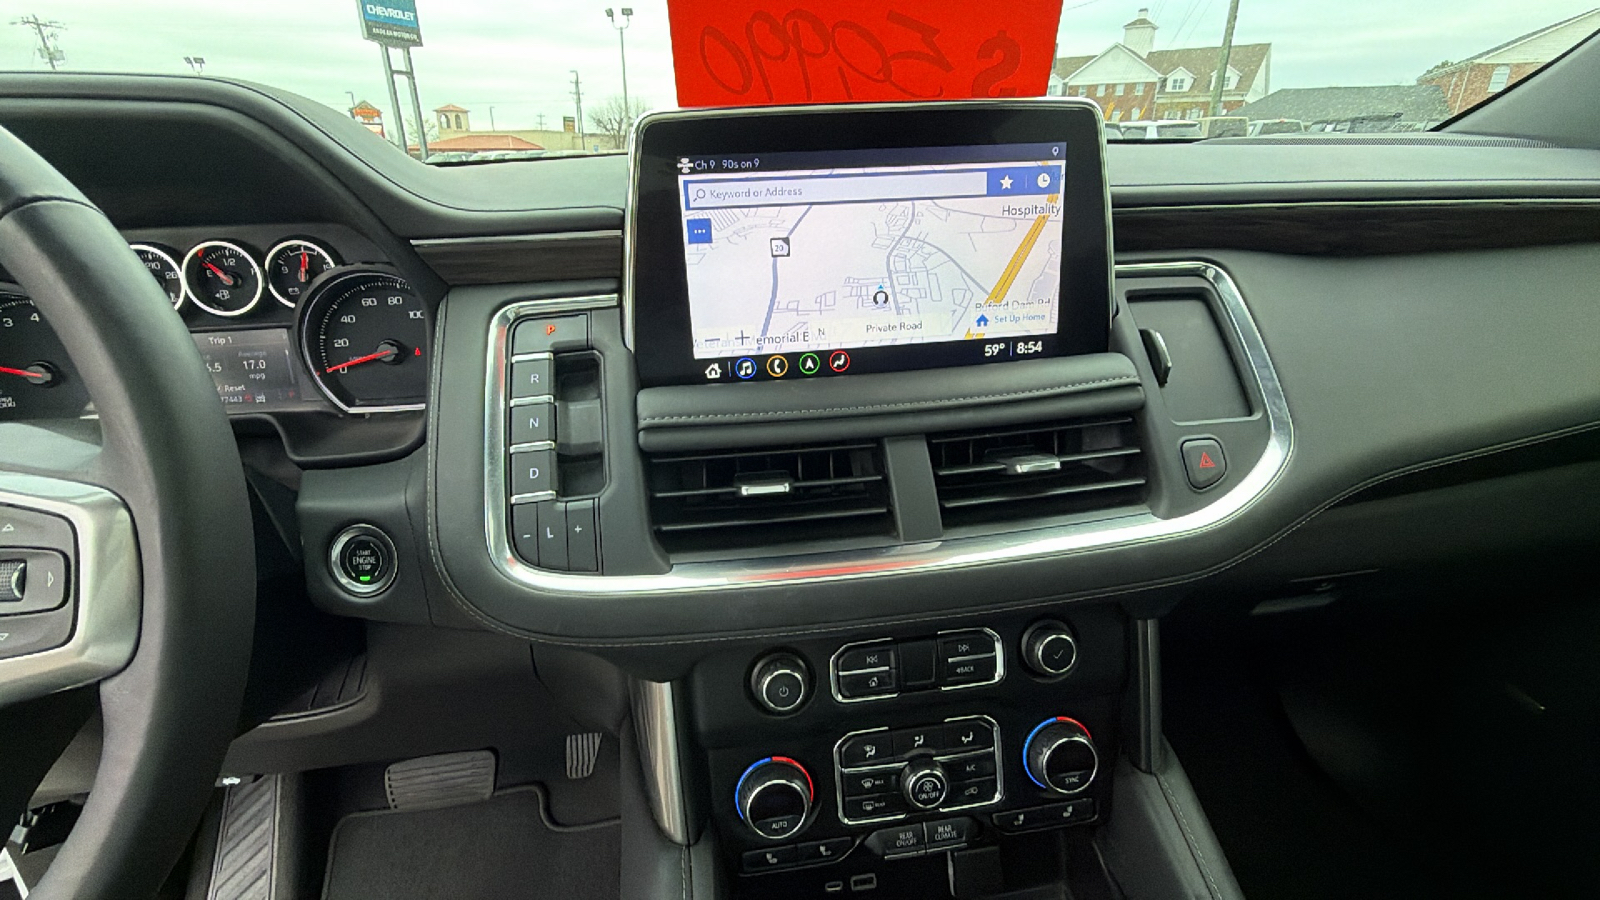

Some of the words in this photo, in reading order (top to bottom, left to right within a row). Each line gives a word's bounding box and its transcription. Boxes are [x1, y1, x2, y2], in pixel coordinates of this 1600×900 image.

[366, 4, 415, 20] CHEVROLET
[694, 160, 707, 170] Ch
[709, 160, 715, 169] 9
[722, 160, 739, 169] 90s
[754, 158, 760, 168] 9
[710, 188, 750, 200] Keyword
[753, 189, 763, 197] or
[765, 186, 803, 197] Address
[1001, 204, 1061, 218] Hospitality
[774, 244, 784, 252] 20
[207, 269, 213, 278] E
[361, 298, 377, 307] 60
[387, 296, 403, 306] 80
[3, 317, 14, 328] 3
[30, 313, 39, 322] 4
[340, 315, 355, 323] 40
[994, 315, 1008, 324] Set
[1010, 315, 1021, 324] Up
[1023, 313, 1046, 322] Home
[546, 324, 556, 335] P
[866, 324, 897, 333] Private
[900, 321, 923, 332] Road
[208, 336, 226, 346] Trip
[227, 335, 233, 344] 1
[333, 338, 349, 348] 20
[1016, 342, 1043, 354] 8:54
[242, 359, 266, 370] 17.0
[249, 372, 266, 380] mpg
[530, 373, 539, 384] R
[224, 384, 246, 393] Reset
[529, 417, 539, 429] N
[529, 467, 539, 479] D
[546, 526, 554, 539] L
[352, 556, 377, 565] ENGINE
[918, 791, 940, 800] ON/OFF
[771, 821, 788, 829] AUTO
[937, 824, 952, 833] REAR
[899, 831, 913, 840] REAR
[934, 830, 958, 842] CLIMATE
